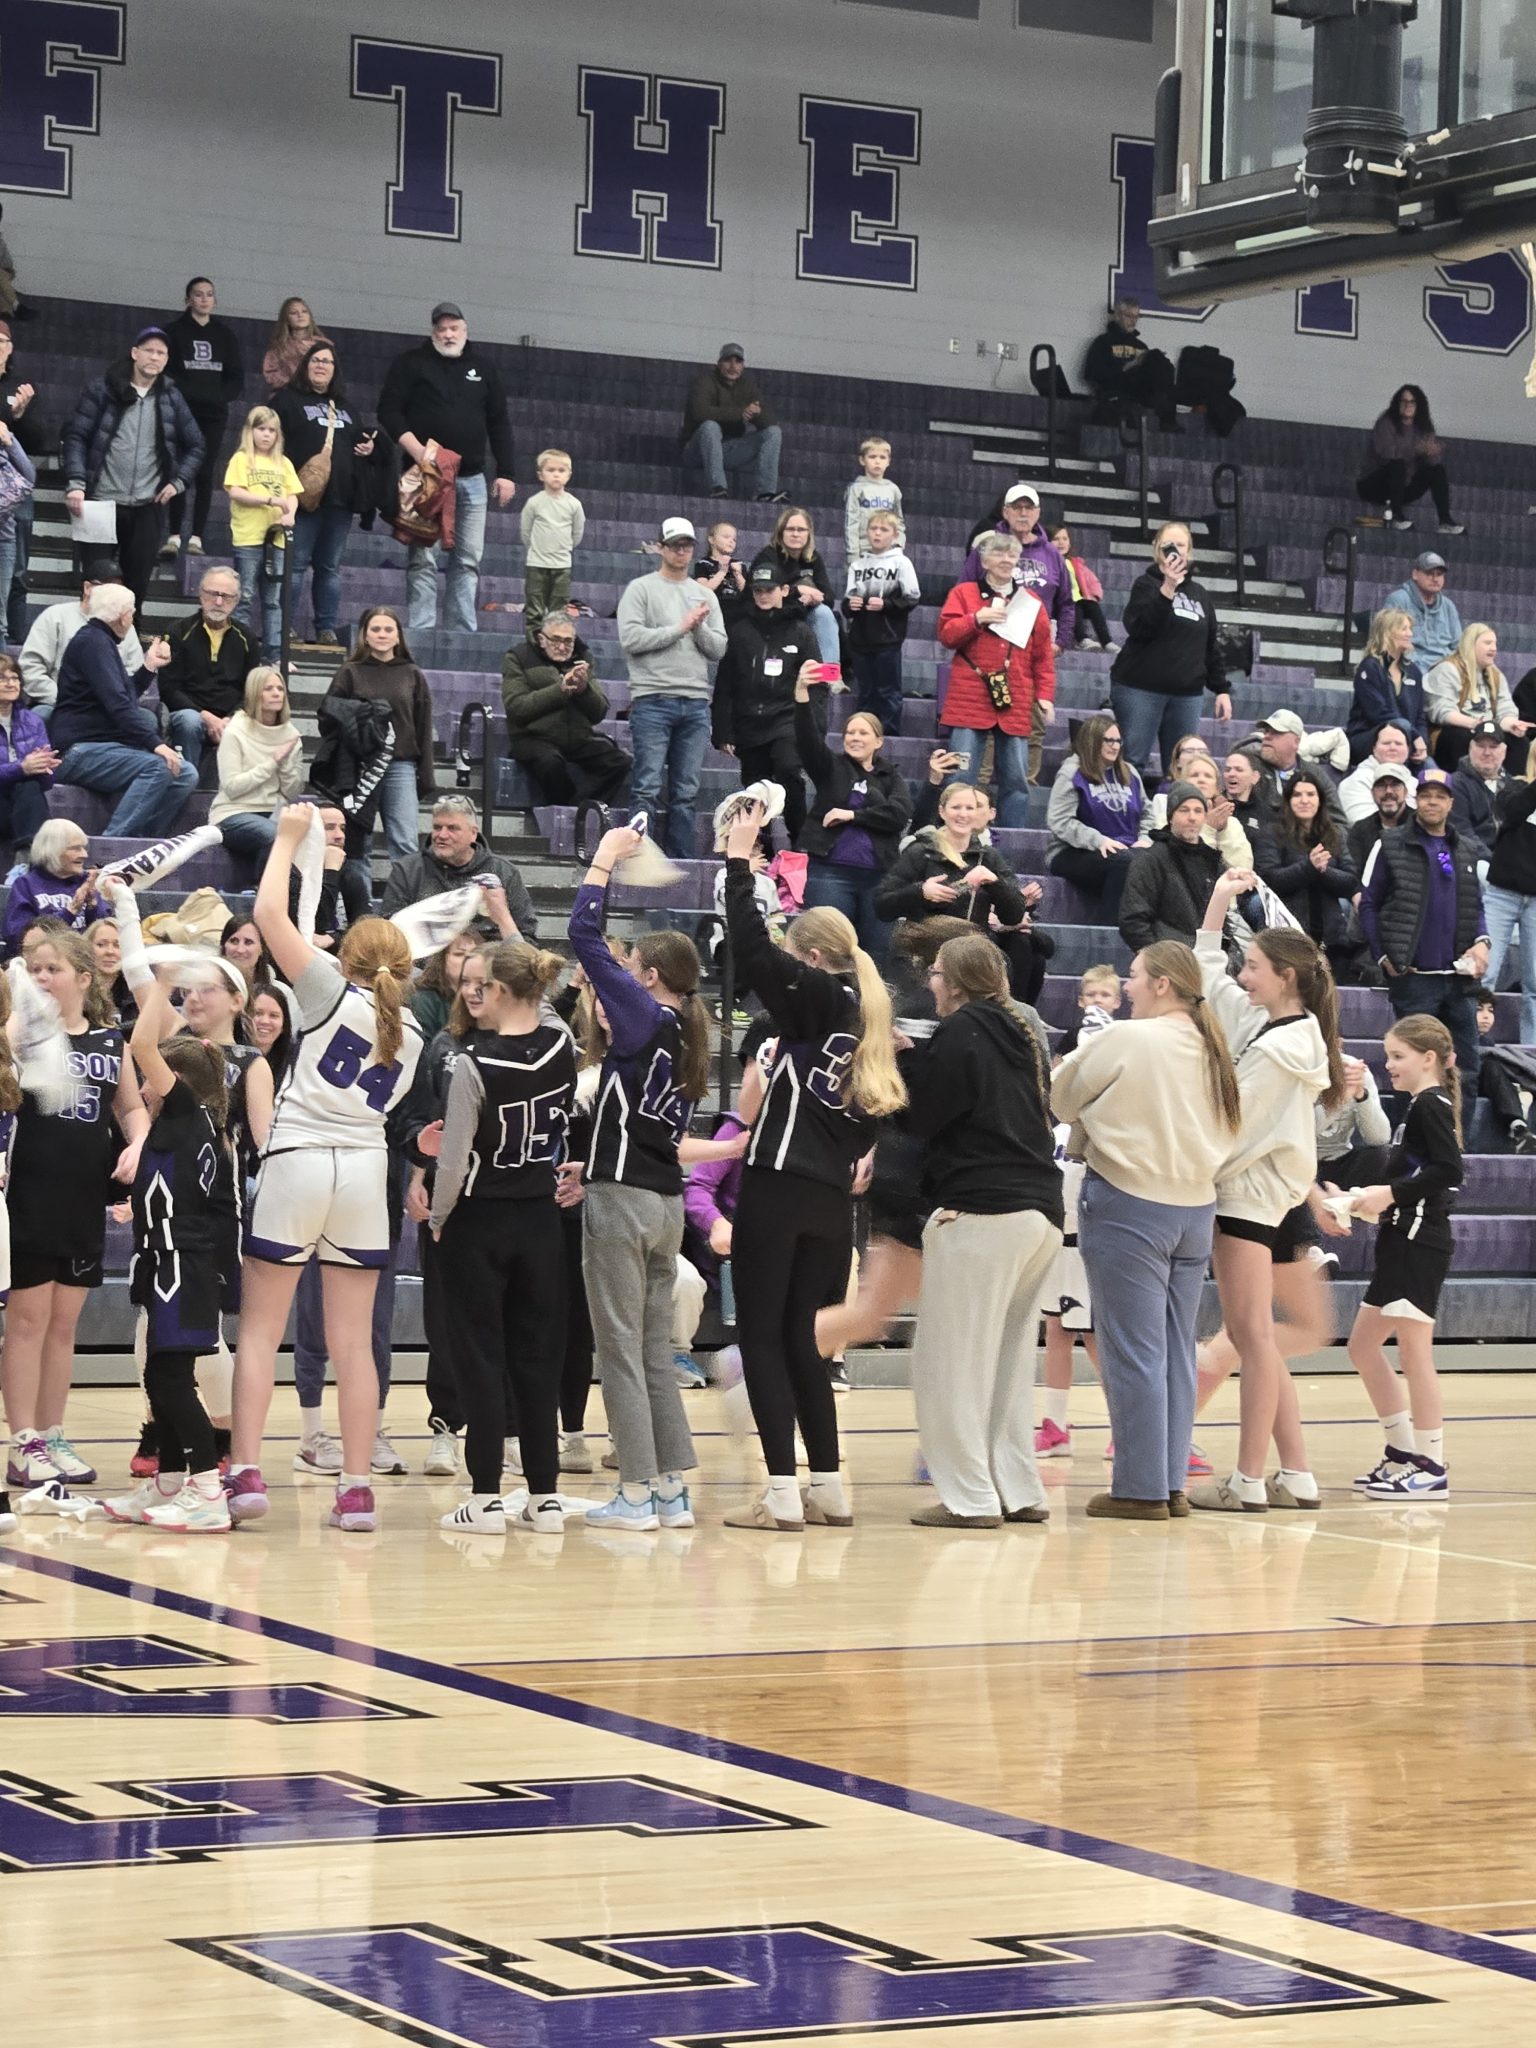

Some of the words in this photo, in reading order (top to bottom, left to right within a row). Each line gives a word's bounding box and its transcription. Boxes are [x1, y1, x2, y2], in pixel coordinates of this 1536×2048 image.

[351, 34, 922, 292] THE
[193, 340, 212, 360] B
[854, 567, 899, 582] BISON
[316, 1023, 404, 1114] 54
